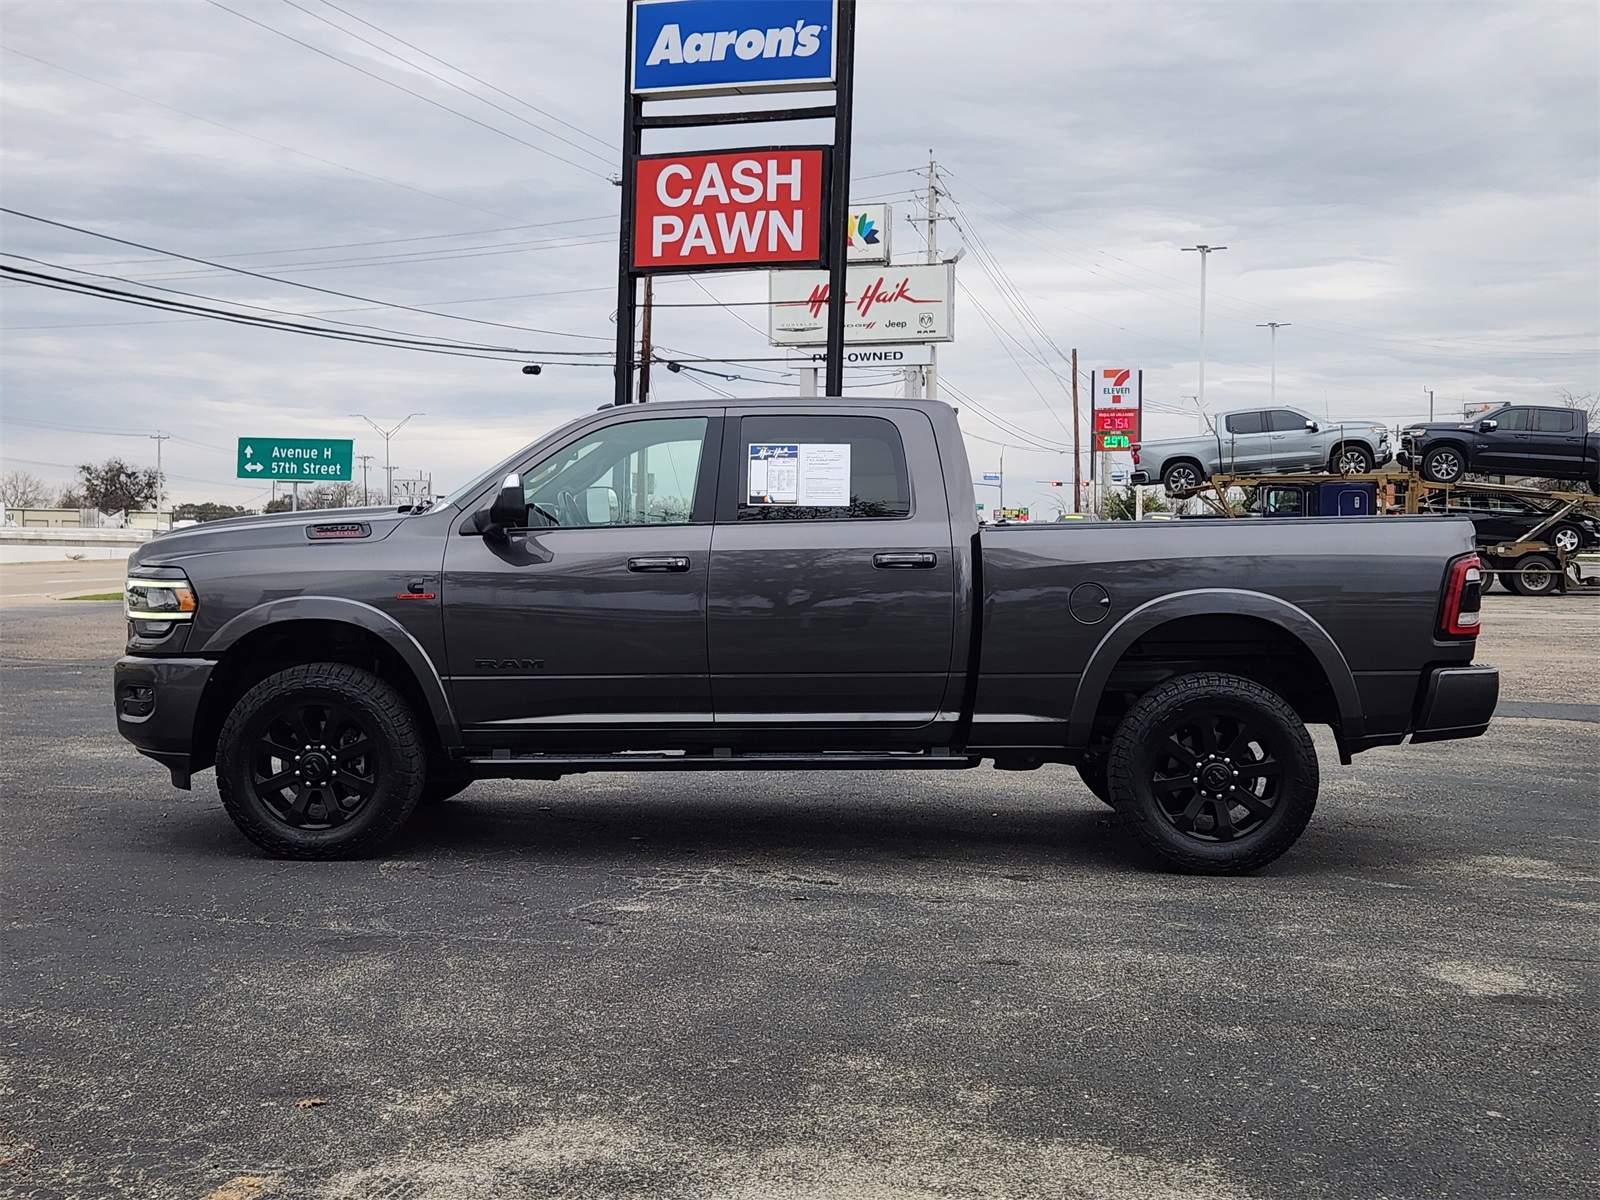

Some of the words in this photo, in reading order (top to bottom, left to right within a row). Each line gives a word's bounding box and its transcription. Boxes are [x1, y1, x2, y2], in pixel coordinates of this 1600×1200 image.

[646, 20, 822, 66] Aaron's
[656, 158, 802, 207] CASH
[652, 209, 804, 258] PAWN
[857, 277, 915, 317] Haik
[885, 320, 907, 329] Jeep
[1103, 369, 1130, 403] 7
[271, 462, 297, 474] 57th
[303, 462, 341, 475] Street
[272, 446, 318, 459] Avenue
[323, 447, 332, 459] H
[474, 658, 545, 669] RAM
